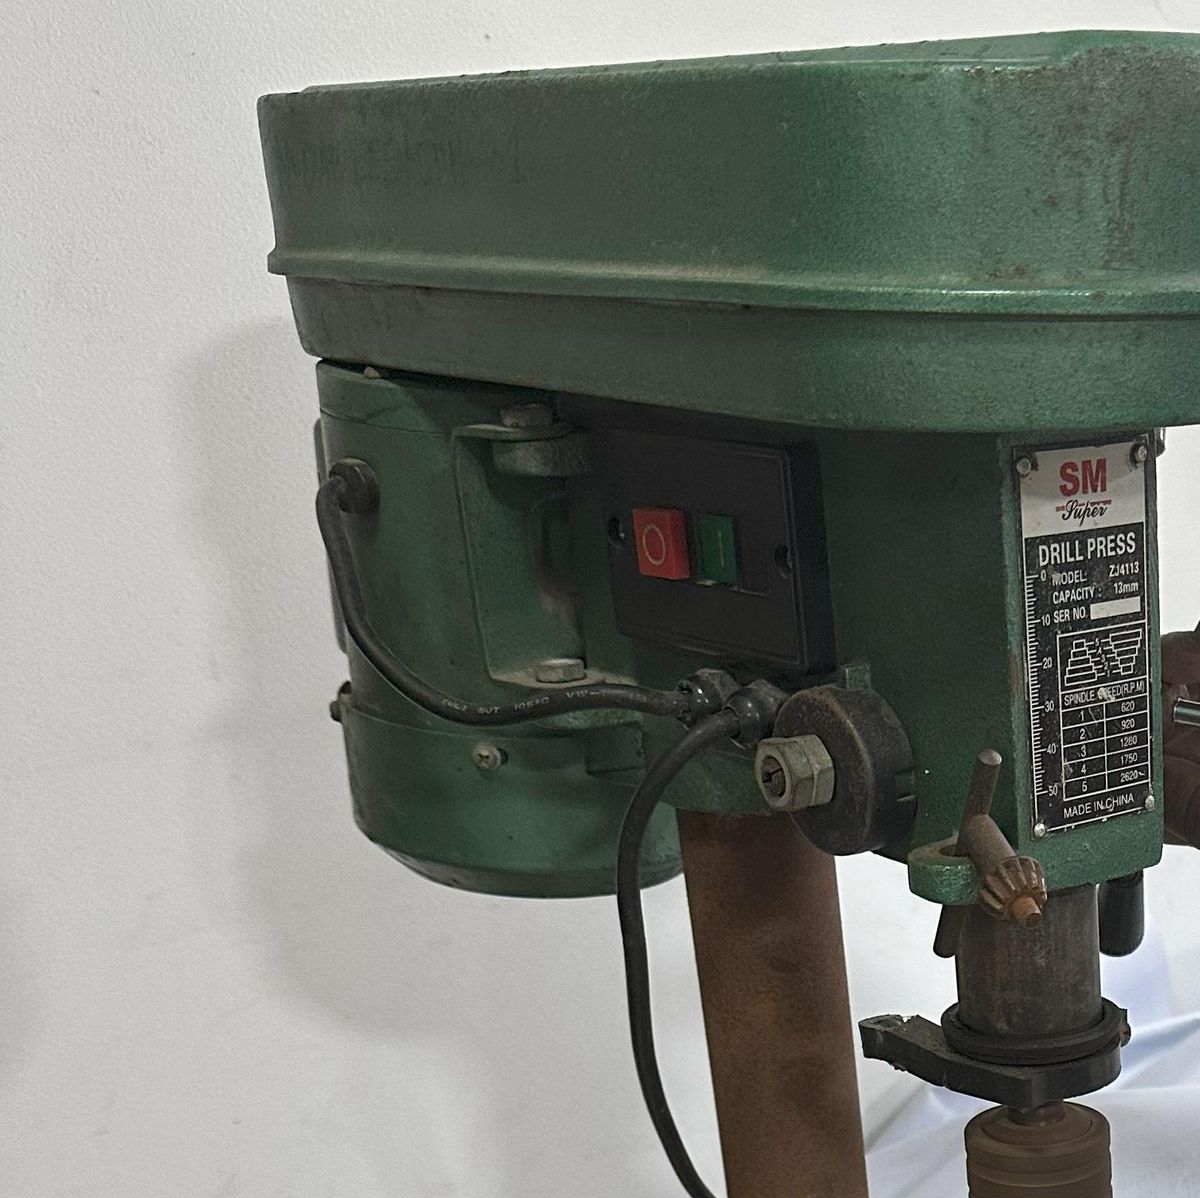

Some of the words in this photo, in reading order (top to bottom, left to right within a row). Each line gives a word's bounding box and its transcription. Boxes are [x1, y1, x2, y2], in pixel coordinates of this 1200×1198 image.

[1059, 458, 1107, 497] SM
[1062, 499, 1109, 527] Super
[1038, 539, 1084, 567] DRILL
[1087, 531, 1137, 560] PRESS
[1109, 561, 1140, 578] ZJ4113
[1113, 581, 1140, 595] 13mm
[1041, 613, 1051, 627] 10
[1053, 608, 1071, 624] SER
[1042, 657, 1053, 669] 20
[1064, 689, 1096, 707] SPINDLE
[1044, 701, 1055, 713] 30
[1121, 700, 1136, 713] 620
[1079, 729, 1086, 740] 2
[1121, 718, 1136, 730] 920
[1047, 743, 1057, 755] 40
[1080, 763, 1087, 775] 4
[1120, 752, 1138, 765] 1750
[1120, 769, 1139, 783] 2620
[1048, 784, 1058, 797] 50
[1063, 802, 1092, 819] MADE
[1093, 799, 1104, 812] IN
[1105, 792, 1135, 810] CHINA
